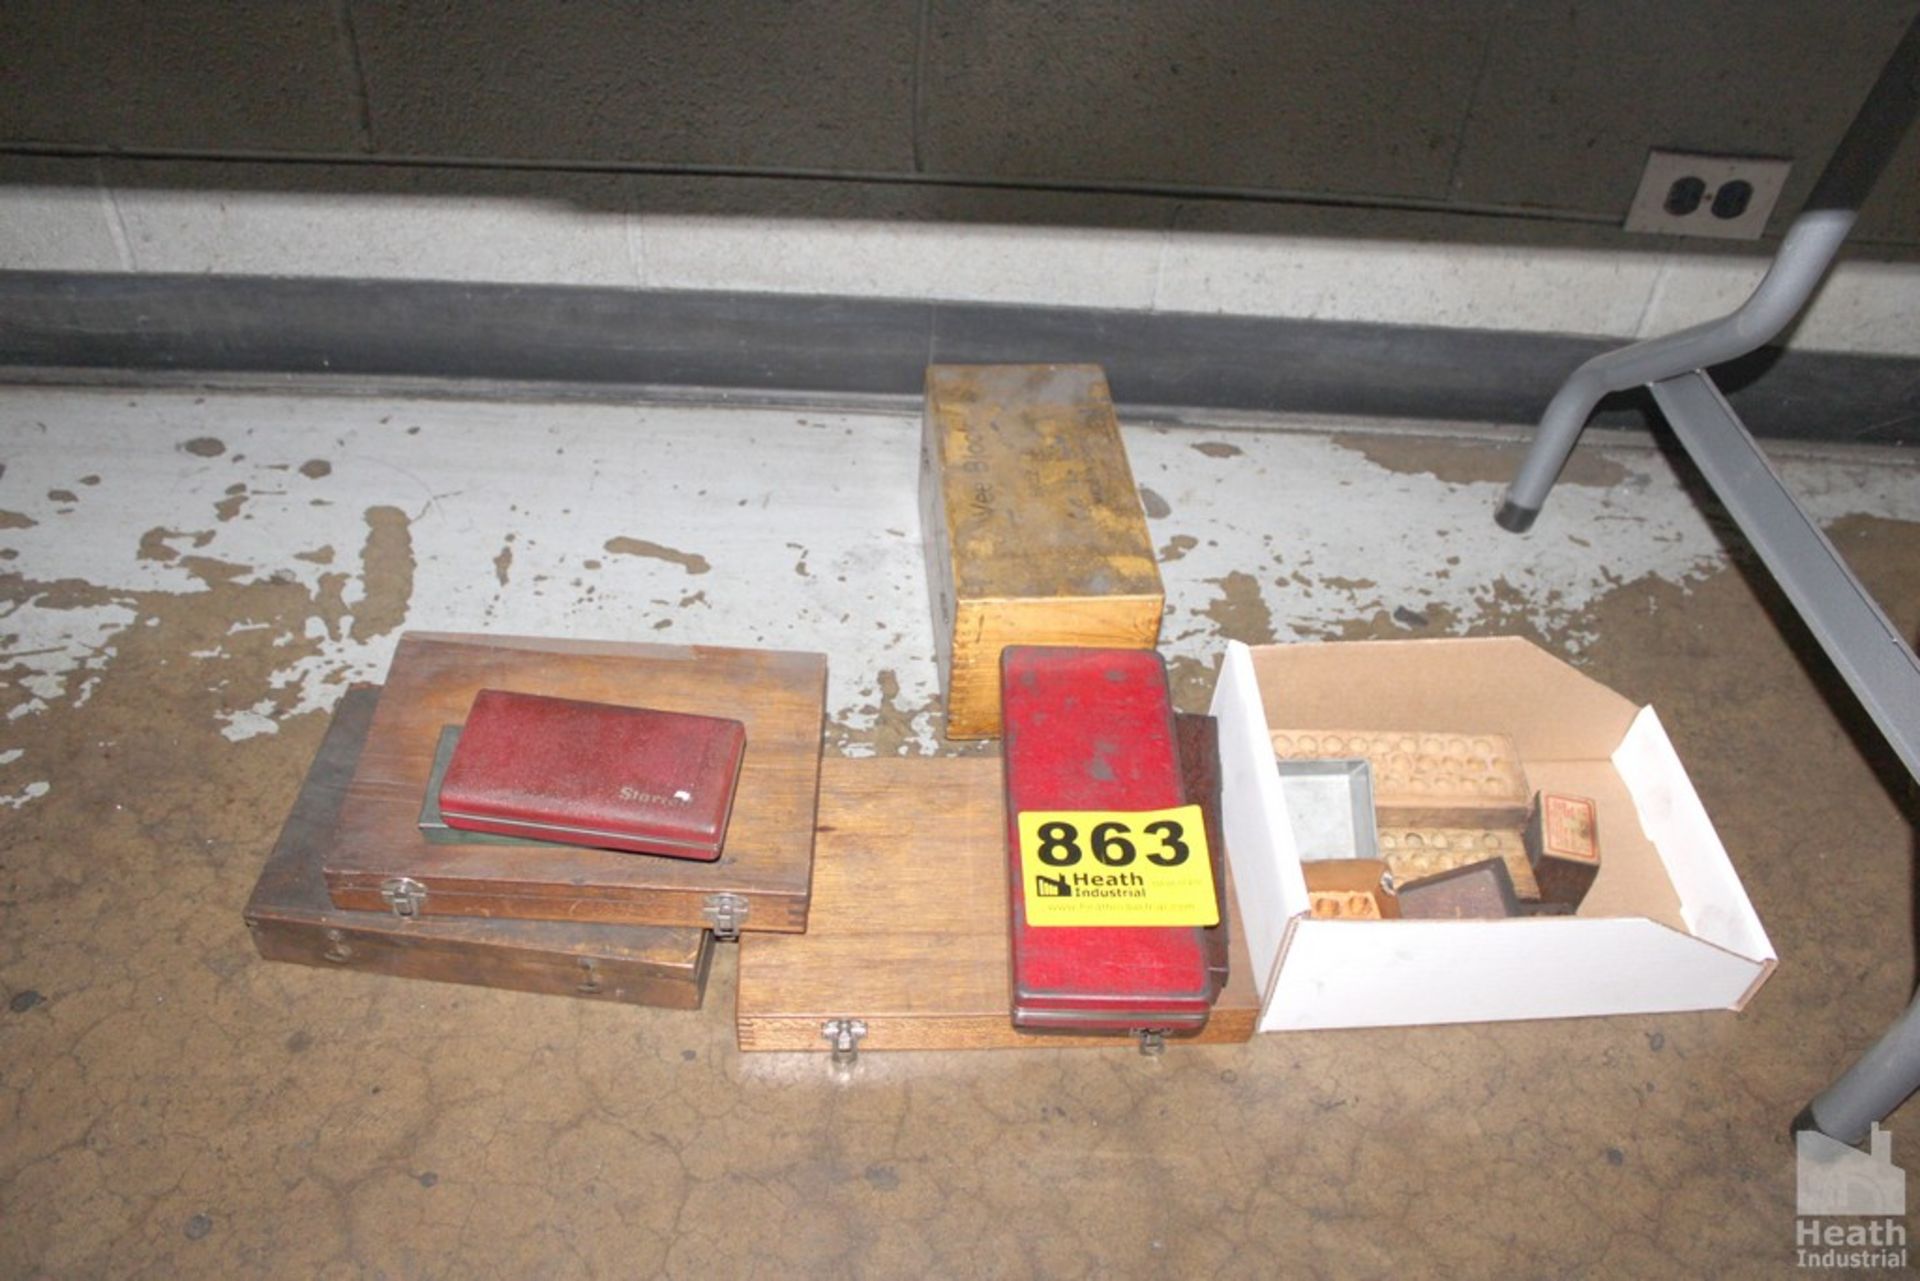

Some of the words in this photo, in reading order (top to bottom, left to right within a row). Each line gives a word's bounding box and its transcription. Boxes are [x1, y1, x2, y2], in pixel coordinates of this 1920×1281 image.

[619, 786, 692, 807] Starre
[1037, 820, 1190, 868] 863
[1073, 872, 1145, 887] Heath
[1074, 888, 1147, 898] Industrial
